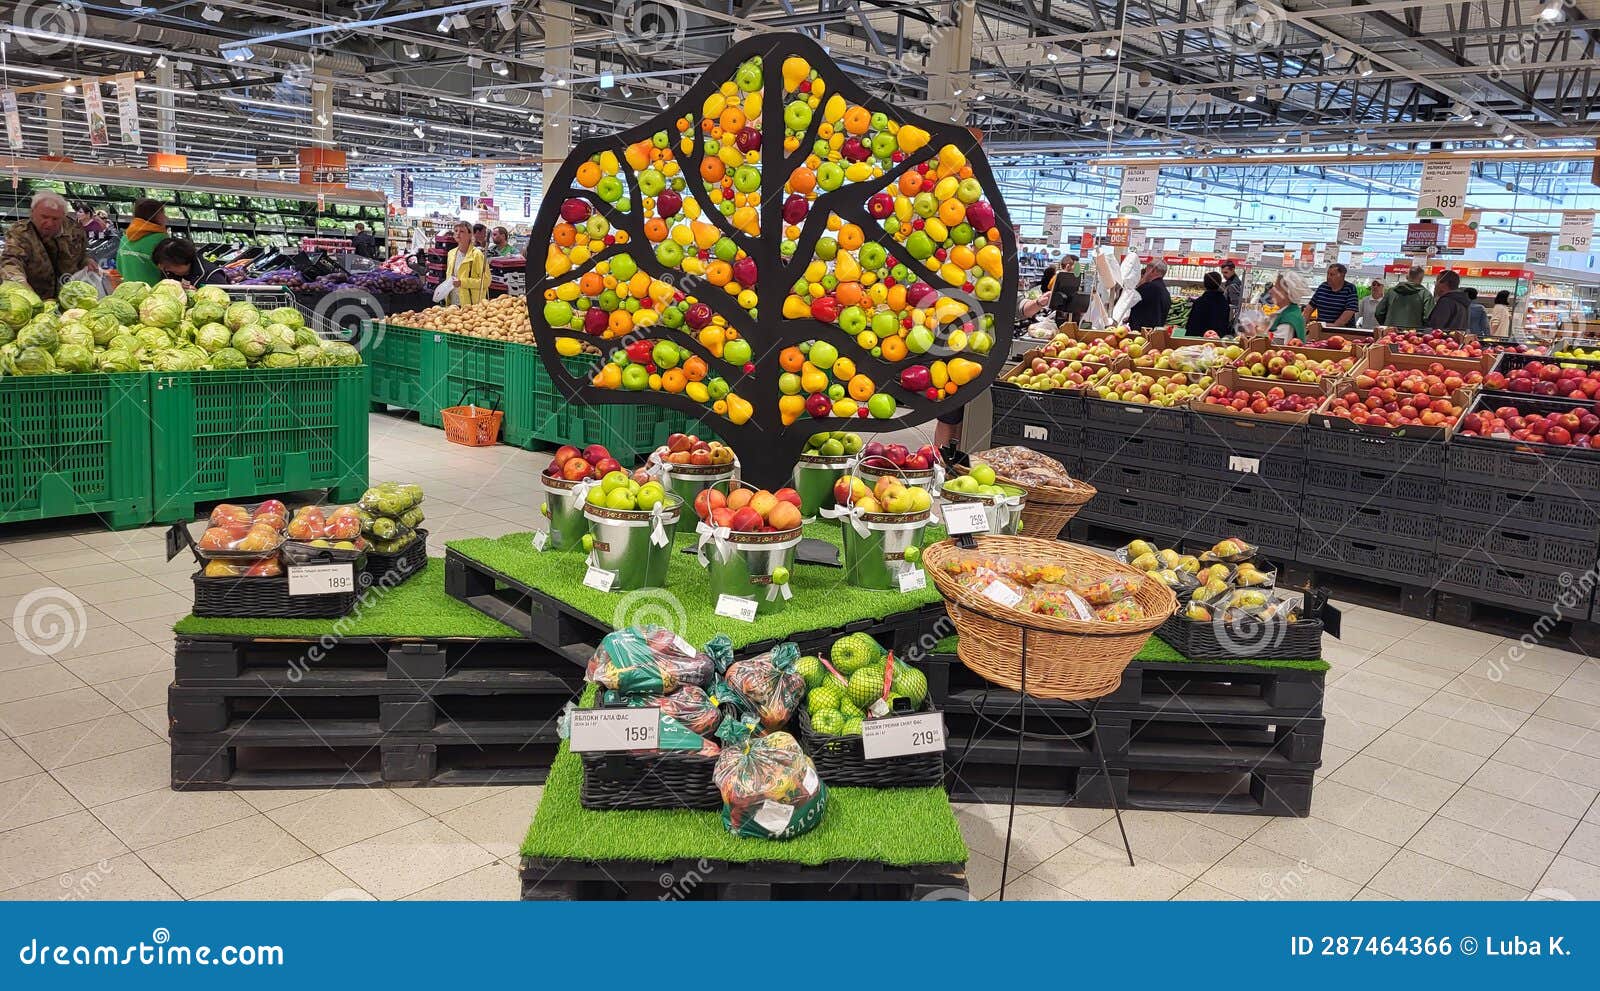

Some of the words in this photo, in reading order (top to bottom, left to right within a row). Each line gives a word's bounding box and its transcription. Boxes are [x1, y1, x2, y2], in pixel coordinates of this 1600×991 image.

[1134, 194, 1149, 206] 159
[1435, 195, 1457, 208] 189
[1571, 236, 1586, 246] 159
[1535, 251, 1546, 259] 159
[328, 577, 346, 588] 189
[624, 726, 648, 741] 159
[912, 730, 933, 746] 219
